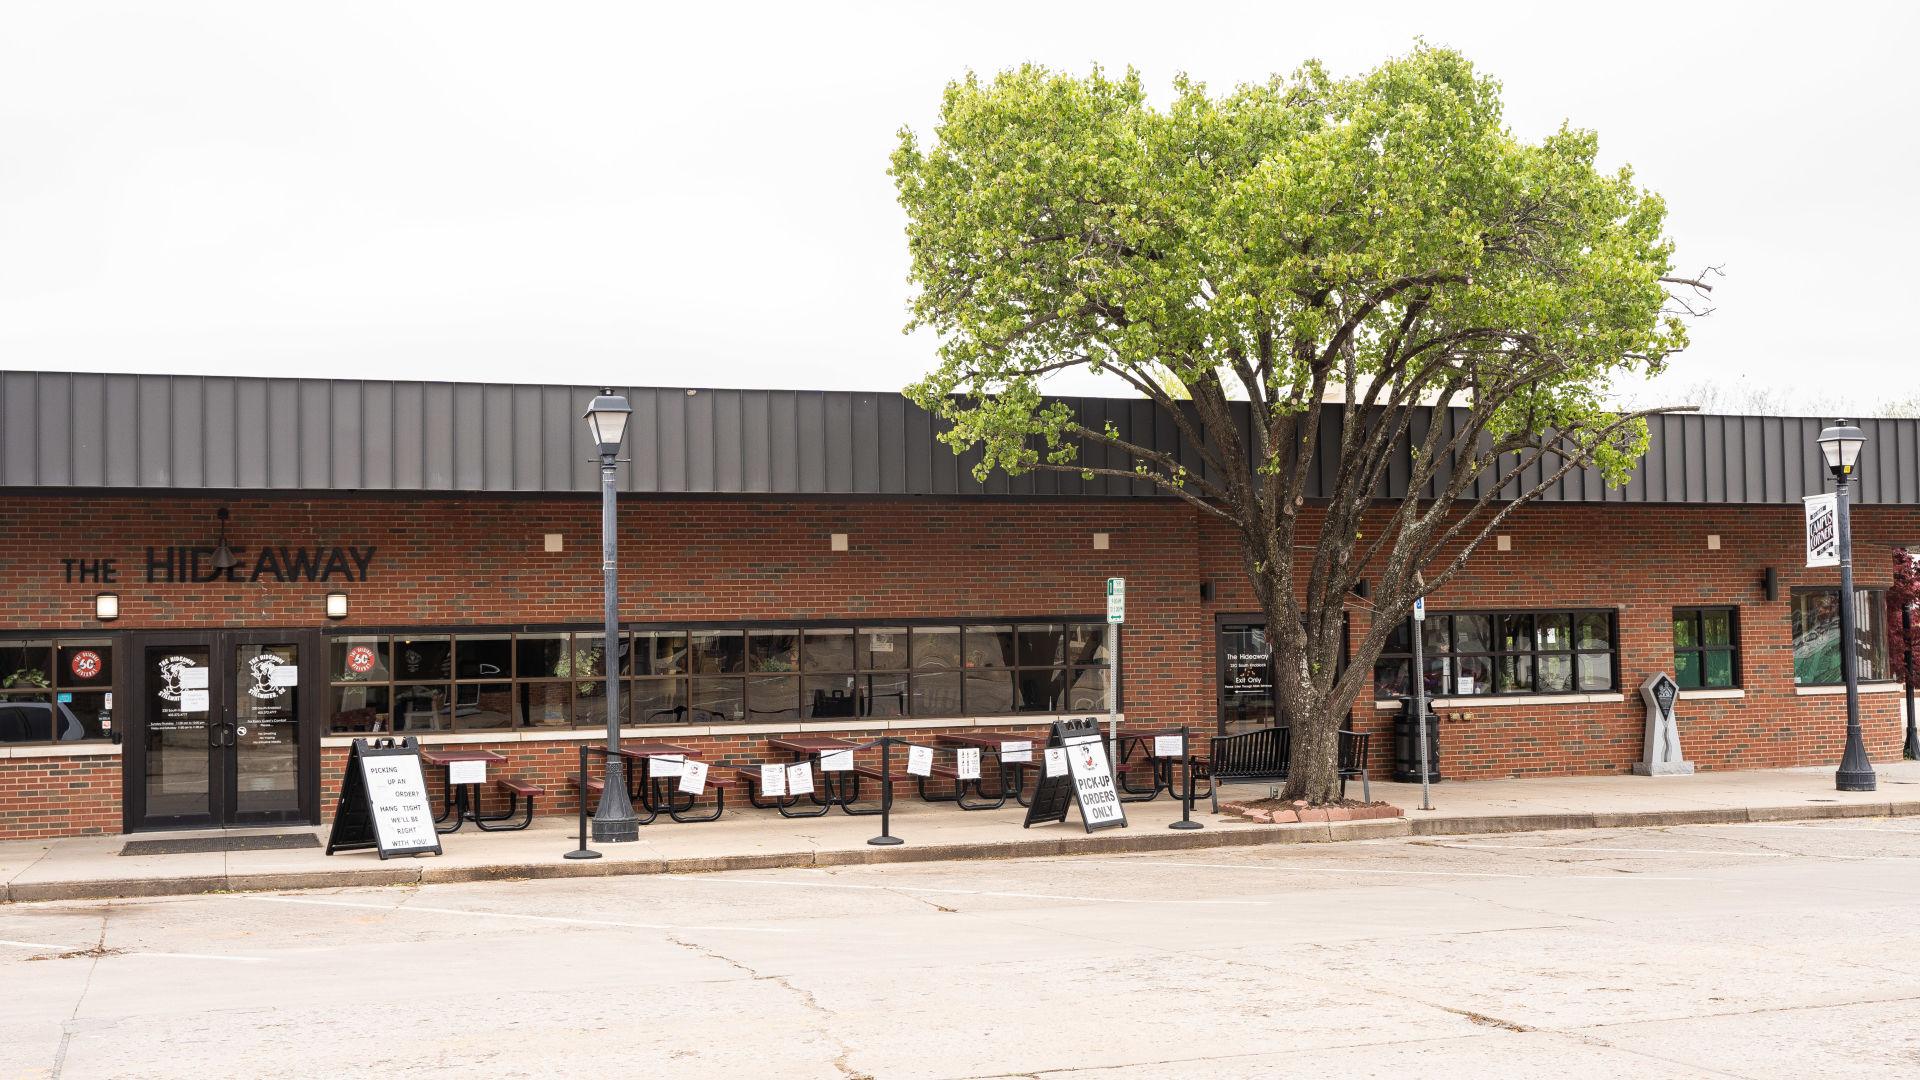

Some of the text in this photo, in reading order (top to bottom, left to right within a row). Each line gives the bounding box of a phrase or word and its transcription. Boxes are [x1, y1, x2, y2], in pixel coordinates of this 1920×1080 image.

[1810, 511, 1833, 537] CAMPUS
[1810, 525, 1834, 550] CORNER
[61, 546, 377, 584] THE HIDEAWAY
[370, 766, 398, 774] PICKING
[1077, 775, 1110, 790] PICK-UP
[1082, 790, 1116, 805] ORDERS
[401, 804, 421, 812] TIGHT
[1092, 805, 1114, 819] ONLY
[396, 827, 417, 835] RIGHT
